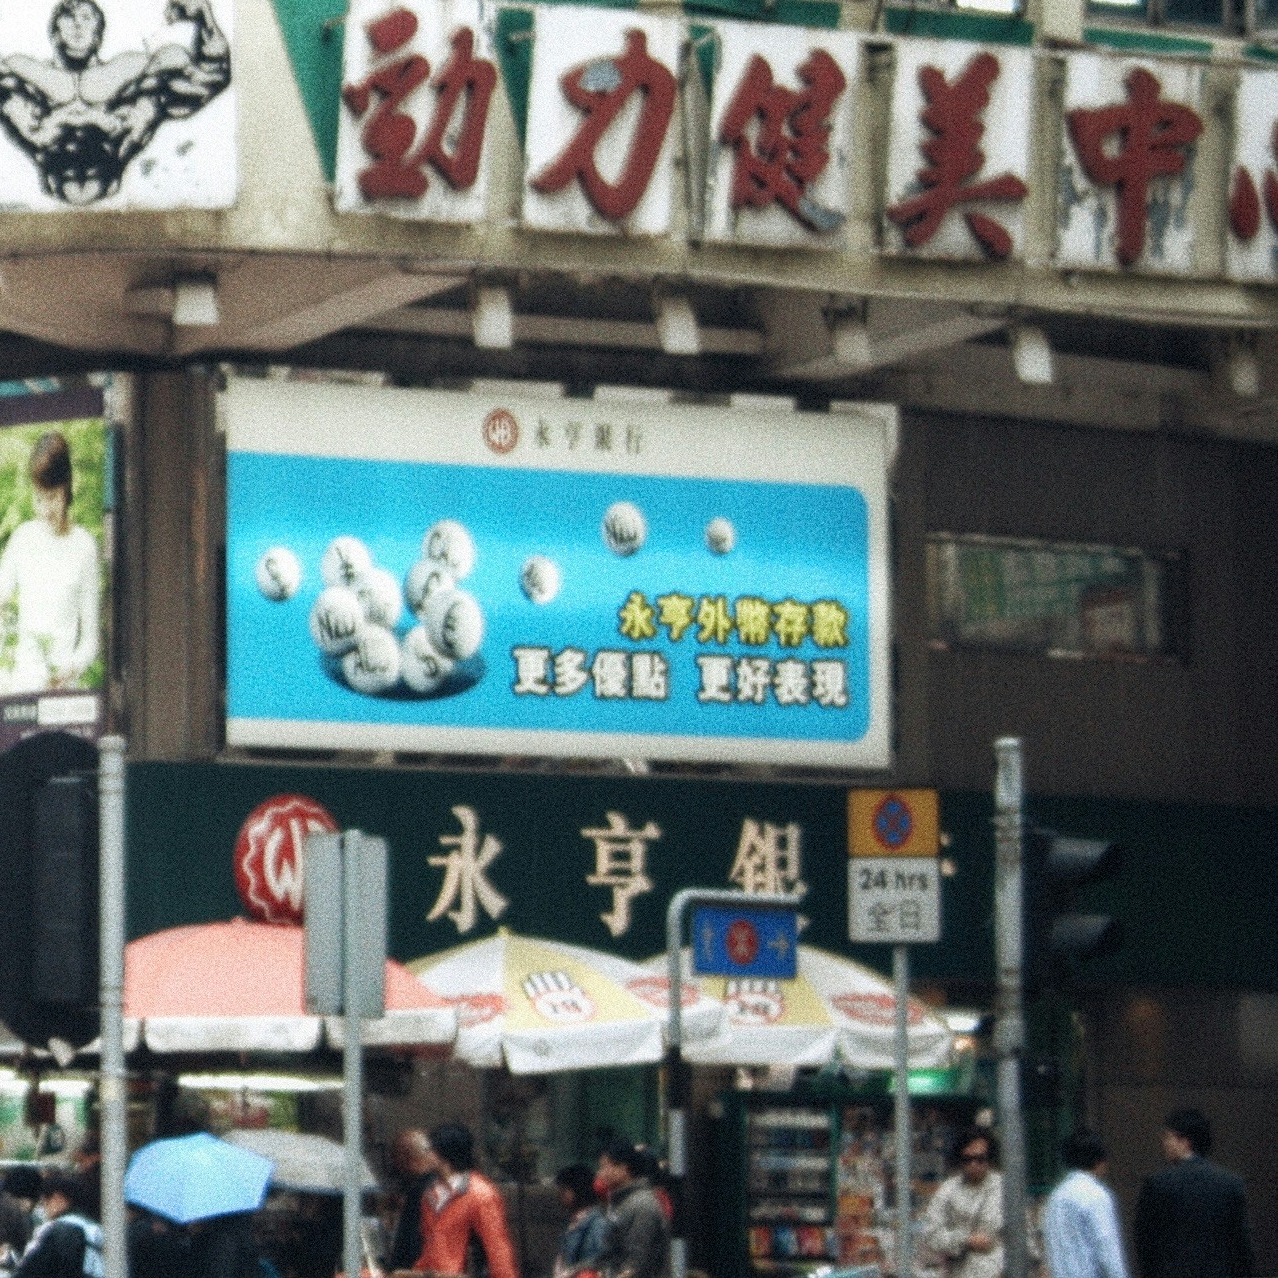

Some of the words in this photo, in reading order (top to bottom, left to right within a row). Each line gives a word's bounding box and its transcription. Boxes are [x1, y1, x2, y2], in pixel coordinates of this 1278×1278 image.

[512, 646, 669, 700] 更多優點
[696, 654, 848, 708] 更好表現
[858, 867, 887, 891] 24
[894, 870, 928, 891] hrs
[866, 901, 921, 933] 全日
